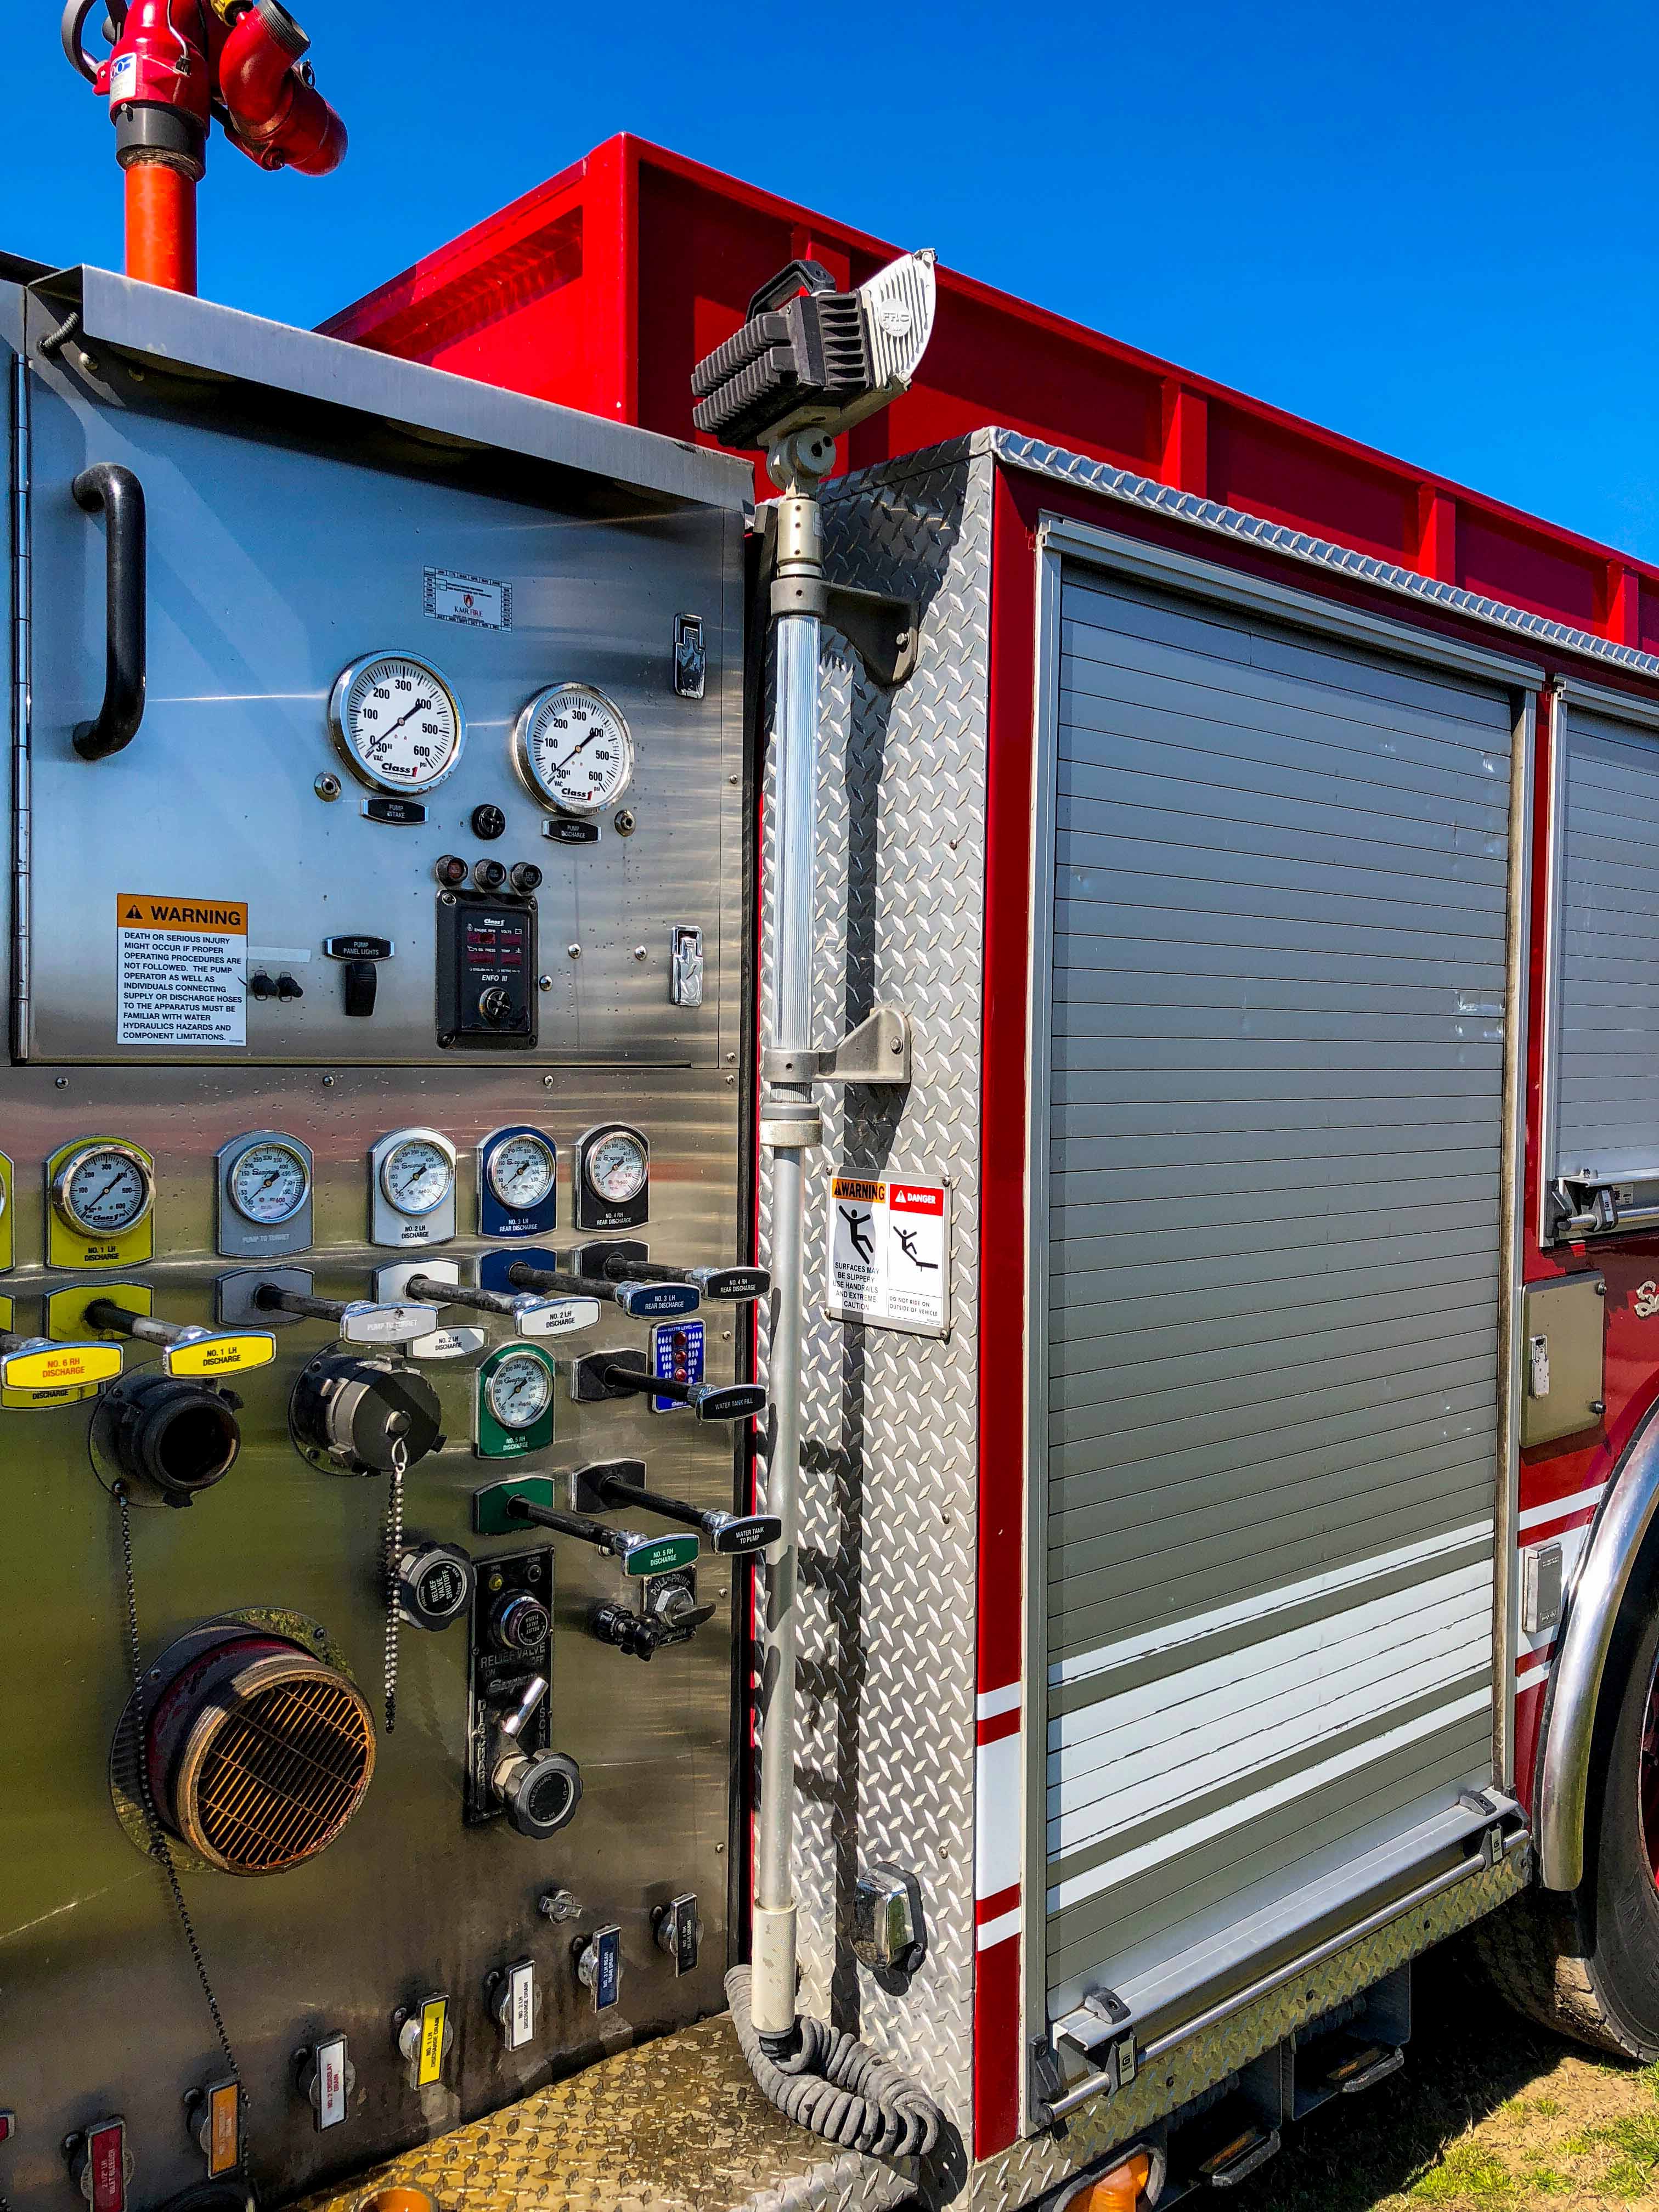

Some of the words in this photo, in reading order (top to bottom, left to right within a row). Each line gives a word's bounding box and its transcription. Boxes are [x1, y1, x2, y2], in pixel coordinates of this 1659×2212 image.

[454, 606, 470, 615] KMR
[470, 609, 483, 617] FIRE
[395, 679, 412, 691] 300
[373, 687, 390, 699] 200
[362, 708, 378, 720] 100
[572, 710, 586, 721] 300
[422, 723, 438, 735] 500
[553, 718, 568, 729] 200
[544, 737, 558, 748] 100
[413, 745, 430, 758] 600
[595, 750, 610, 761] 500
[588, 771, 603, 782] 600
[388, 804, 404, 812] PUMP
[387, 810, 406, 819] INTAKE
[561, 831, 585, 839] DISCHARGE
[150, 905, 241, 926] WARNING
[167, 934, 201, 943] SERIOUS
[124, 952, 169, 961] OPERATING
[171, 955, 224, 964] PROCEDURES
[143, 963, 188, 972] FOLLOWED.
[124, 972, 166, 980] OPERATOR
[123, 982, 173, 991] INDIVIDUALS
[175, 984, 227, 992] CONNECTING
[170, 994, 215, 1002] DISCHARGE
[154, 1003, 200, 1011] APPARATUS
[176, 1032, 226, 1041] LIMITATIONS.
[841, 1182, 885, 1200] WARNING
[907, 1193, 936, 1204] DANGER
[84, 1253, 119, 1261] DISCHARGE
[834, 1262, 866, 1273] SURFACES
[866, 1266, 879, 1274] MAY
[847, 1273, 875, 1283] SLIPPERY
[833, 1280, 844, 1289] USE
[845, 1282, 878, 1294] HANDRAILS
[836, 1290, 848, 1299] AND
[849, 1292, 876, 1303] EXTREME
[658, 1301, 684, 1309] DISCHARGE
[844, 1300, 870, 1311] CAUTION
[889, 1304, 910, 1313] OUTSIDE
[919, 1308, 938, 1317] VEHICLE
[546, 1317, 575, 1328] DISCHARGE
[206, 1348, 218, 1357] NO.
[47, 1359, 61, 1369] NO.
[63, 1358, 68, 1367] 6
[70, 1357, 80, 1365] RH
[202, 1354, 241, 1367] DISCHARGE
[42, 1365, 86, 1378] DISCHARGE
[715, 1401, 731, 1410] WATER
[503, 1442, 528, 1451] DISCHARGE
[736, 1530, 752, 1538] WATER
[752, 1526, 764, 1534] TANK
[747, 1534, 760, 1543] PUMP
[650, 1554, 676, 1566] DISCHARGE
[653, 1550, 662, 1559] NO.
[430, 1579, 439, 1602] RELIEF
[436, 1577, 445, 1599] VALVE
[442, 1570, 453, 1600] SHUTOFF
[530, 1775, 552, 1808] PRESSURE
